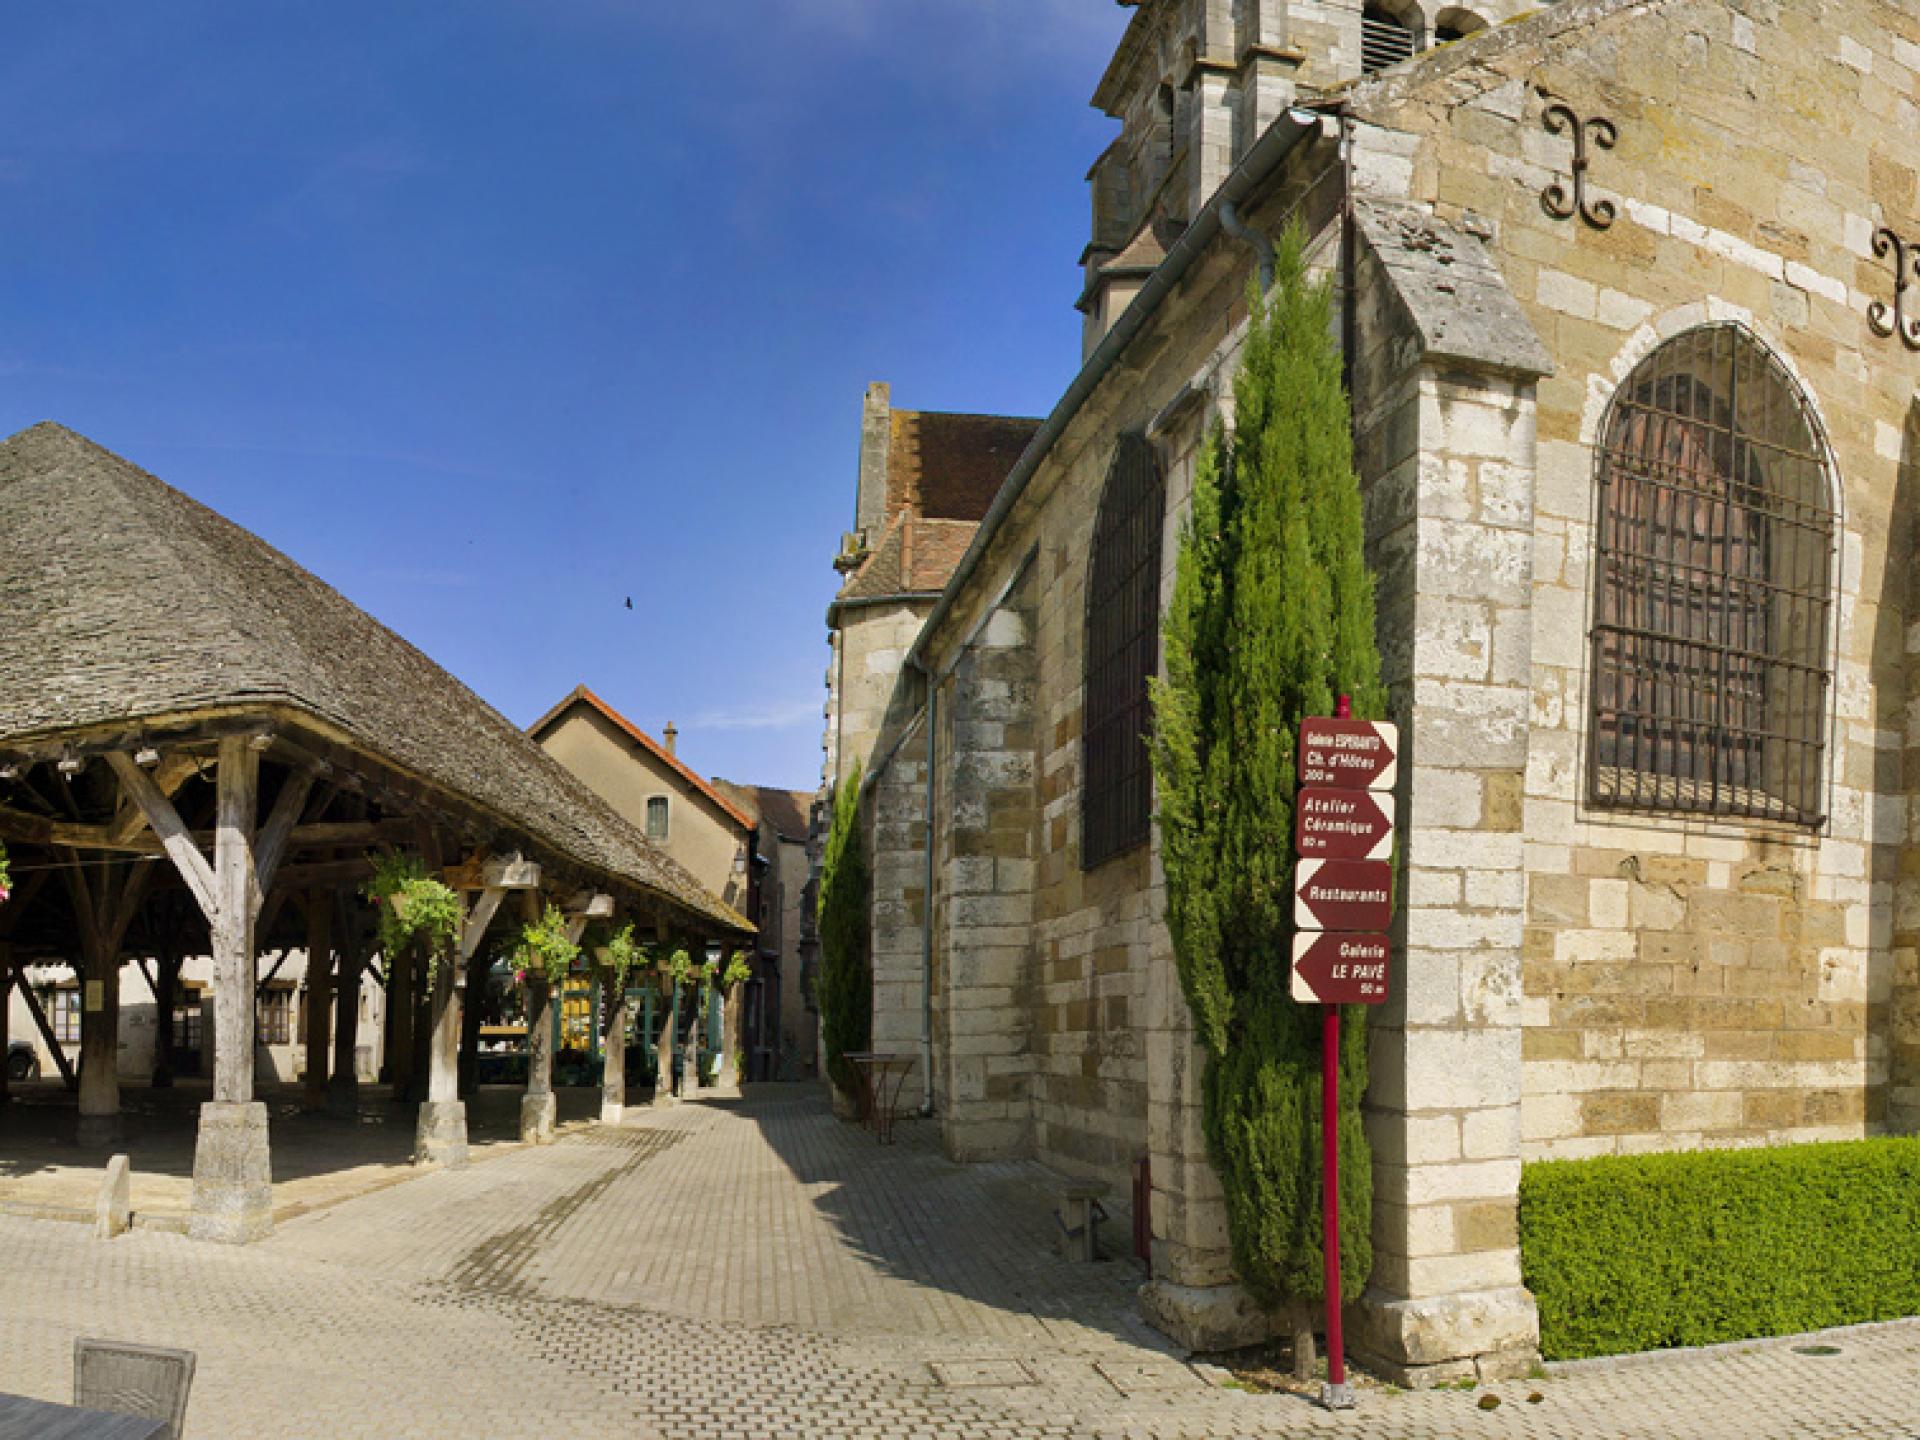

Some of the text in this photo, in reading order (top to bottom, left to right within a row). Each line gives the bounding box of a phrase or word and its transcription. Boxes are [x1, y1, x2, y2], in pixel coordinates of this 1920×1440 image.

[1325, 773, 1334, 782] m
[1303, 797, 1355, 813] Atelier
[1304, 816, 1373, 836] Céramique
[1309, 885, 1388, 903] Restaurants
[1340, 942, 1385, 958] Galerie
[1332, 962, 1385, 980] LE PAVÉ
